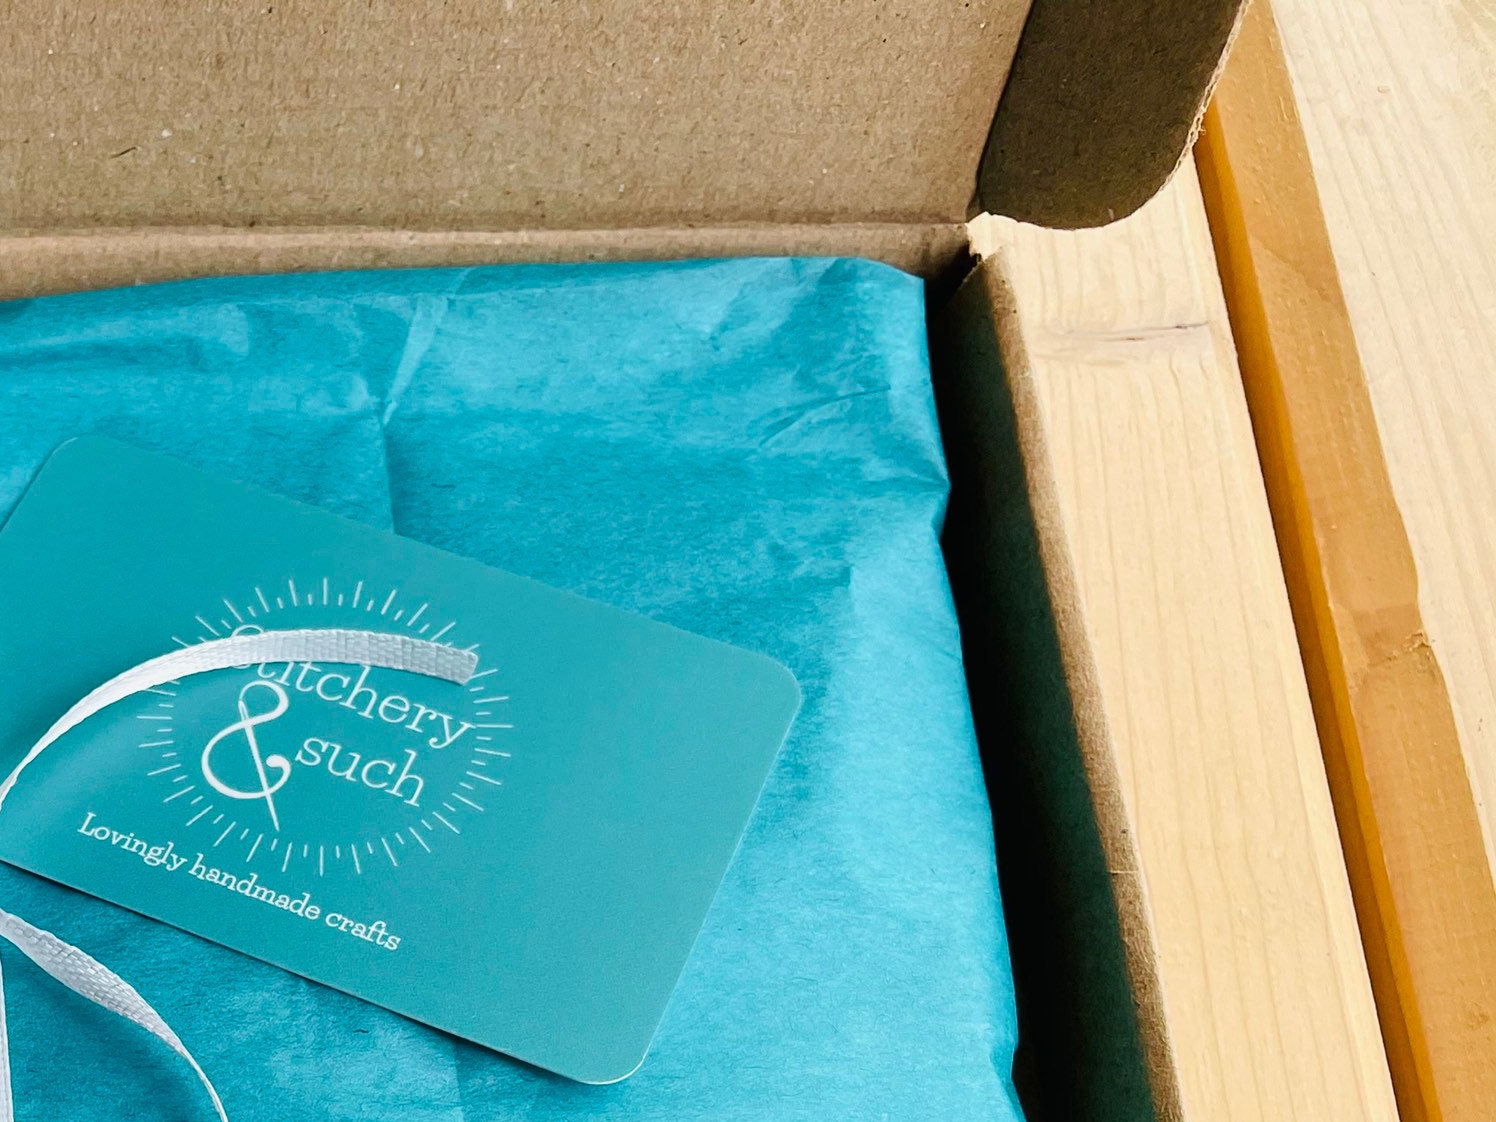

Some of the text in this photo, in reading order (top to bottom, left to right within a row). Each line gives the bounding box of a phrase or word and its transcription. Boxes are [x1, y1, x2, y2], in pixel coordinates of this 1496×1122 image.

[201, 680, 425, 831] & such
[77, 812, 402, 952] Lovingly handmade crafts
